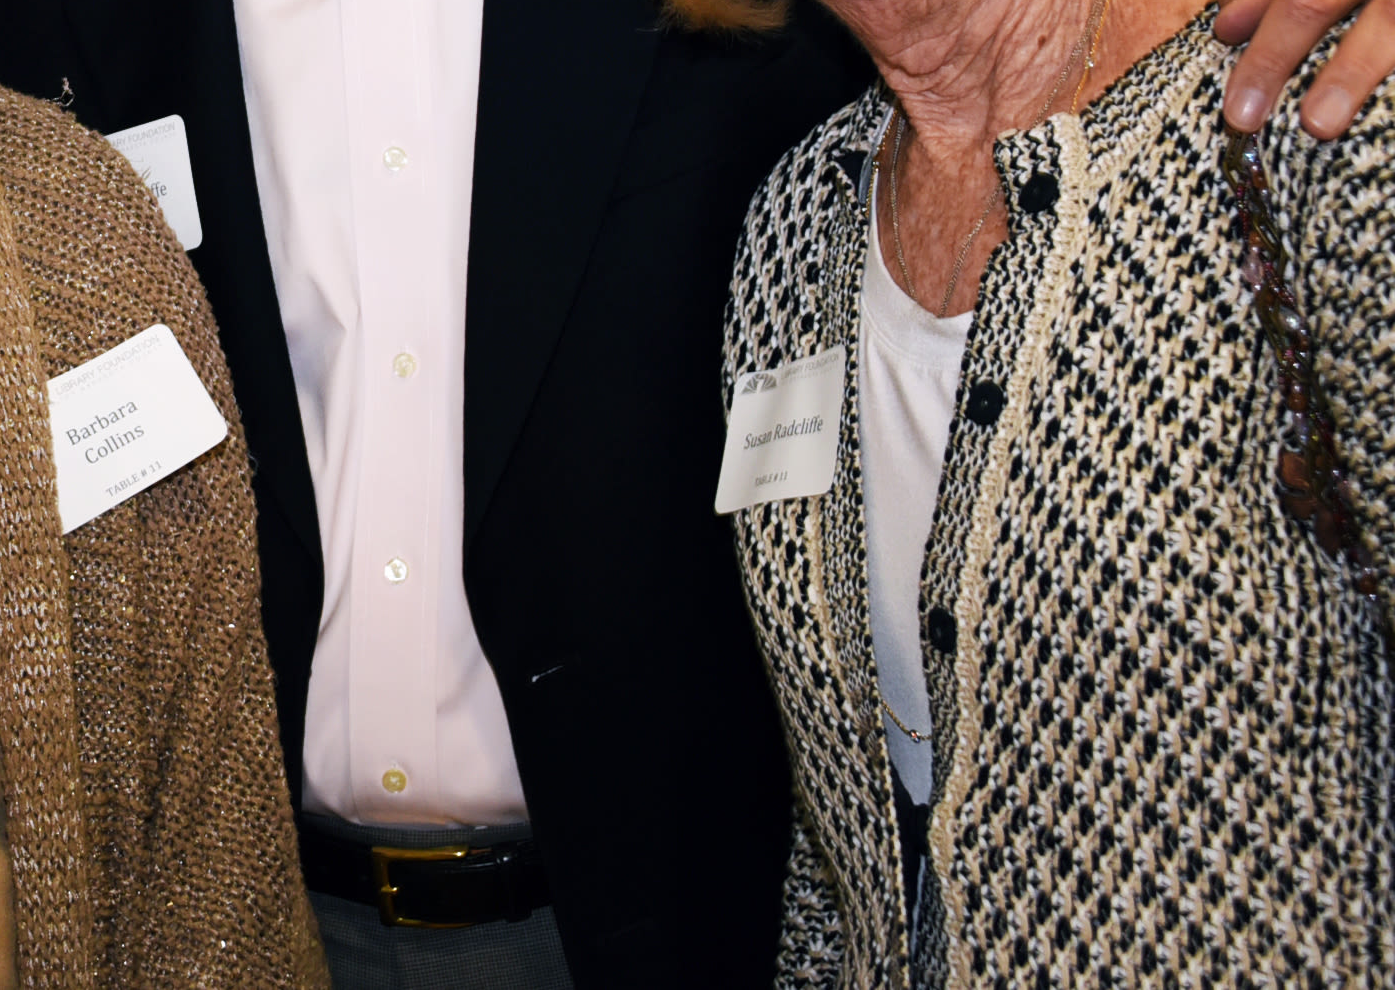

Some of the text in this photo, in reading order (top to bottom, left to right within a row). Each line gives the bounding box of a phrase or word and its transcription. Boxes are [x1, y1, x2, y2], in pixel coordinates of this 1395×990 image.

[55, 369, 96, 396] LIBRARY
[97, 334, 162, 372] FOUNDATION
[66, 401, 138, 446] Barbara
[743, 414, 823, 450] Susan Radcliffe
[85, 425, 145, 464] Collins
[105, 473, 140, 497] TABLE
[148, 460, 162, 473] 11
